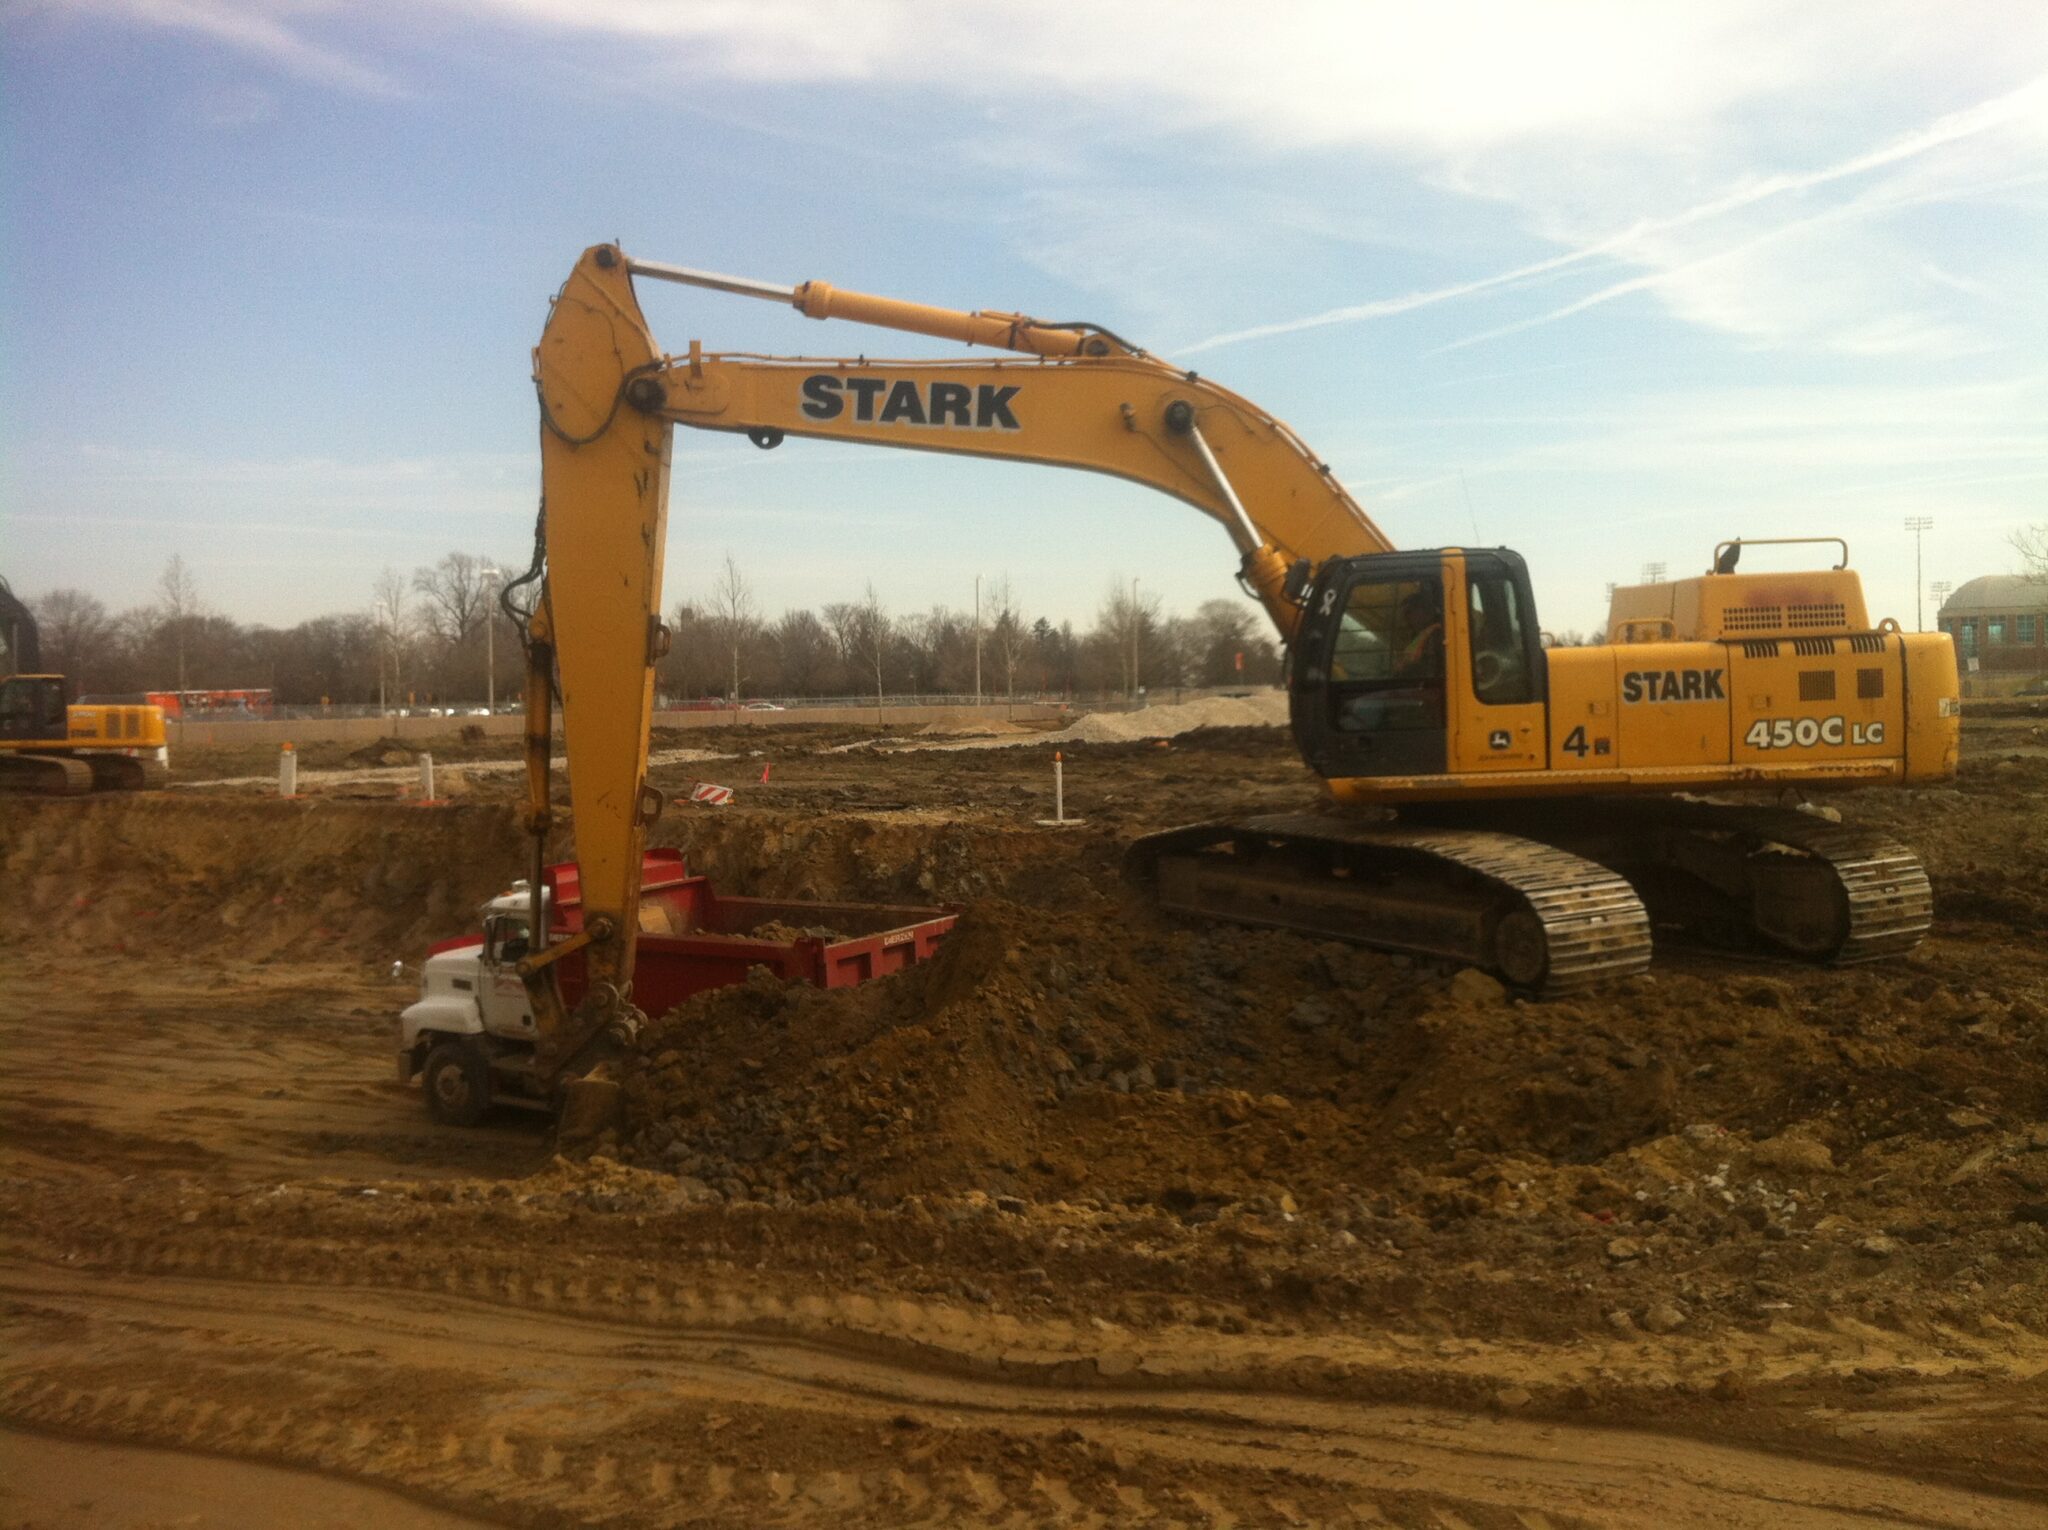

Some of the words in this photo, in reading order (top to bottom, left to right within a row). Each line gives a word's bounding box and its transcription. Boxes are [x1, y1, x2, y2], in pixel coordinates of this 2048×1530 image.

[801, 374, 1021, 431] STARK
[1623, 668, 1725, 702] STARK
[1563, 725, 1590, 757] 4
[1745, 716, 1844, 749] 450C
[1851, 722, 1884, 745] LC
